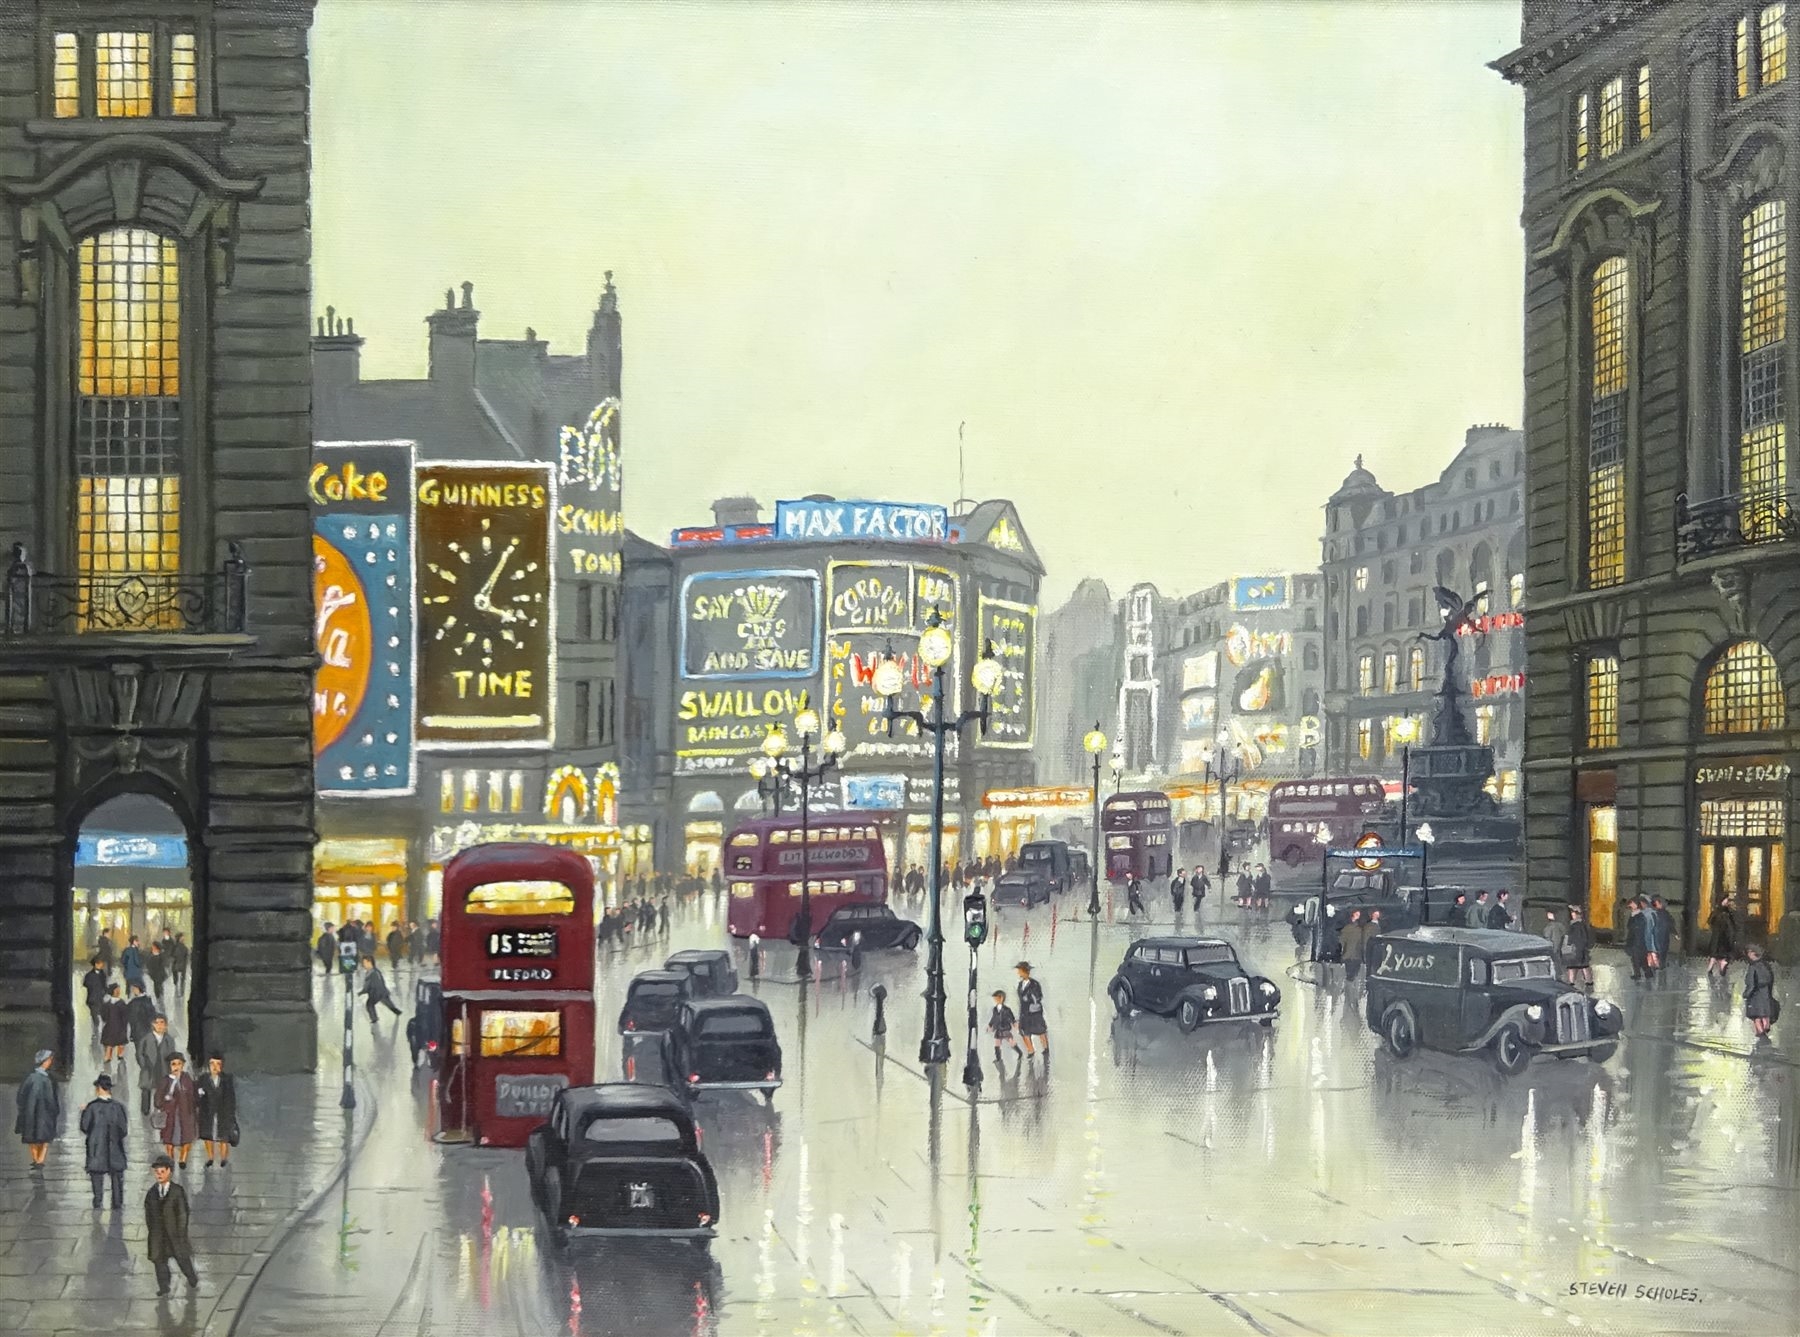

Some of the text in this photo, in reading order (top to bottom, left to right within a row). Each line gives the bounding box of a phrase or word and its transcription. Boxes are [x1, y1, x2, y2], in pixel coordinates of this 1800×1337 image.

[308, 462, 388, 505] Coke
[418, 478, 545, 508] GUINNESS
[785, 507, 844, 537] MAX
[854, 506, 945, 538] FACTOR
[692, 594, 734, 621] SAY
[703, 649, 810, 672] AND SAVE
[451, 669, 533, 699] TIME
[678, 688, 809, 720] SWALLOW
[490, 934, 513, 954] 15
[1376, 943, 1436, 976] Lyons
[1569, 1281, 1628, 1298] STEVEN
